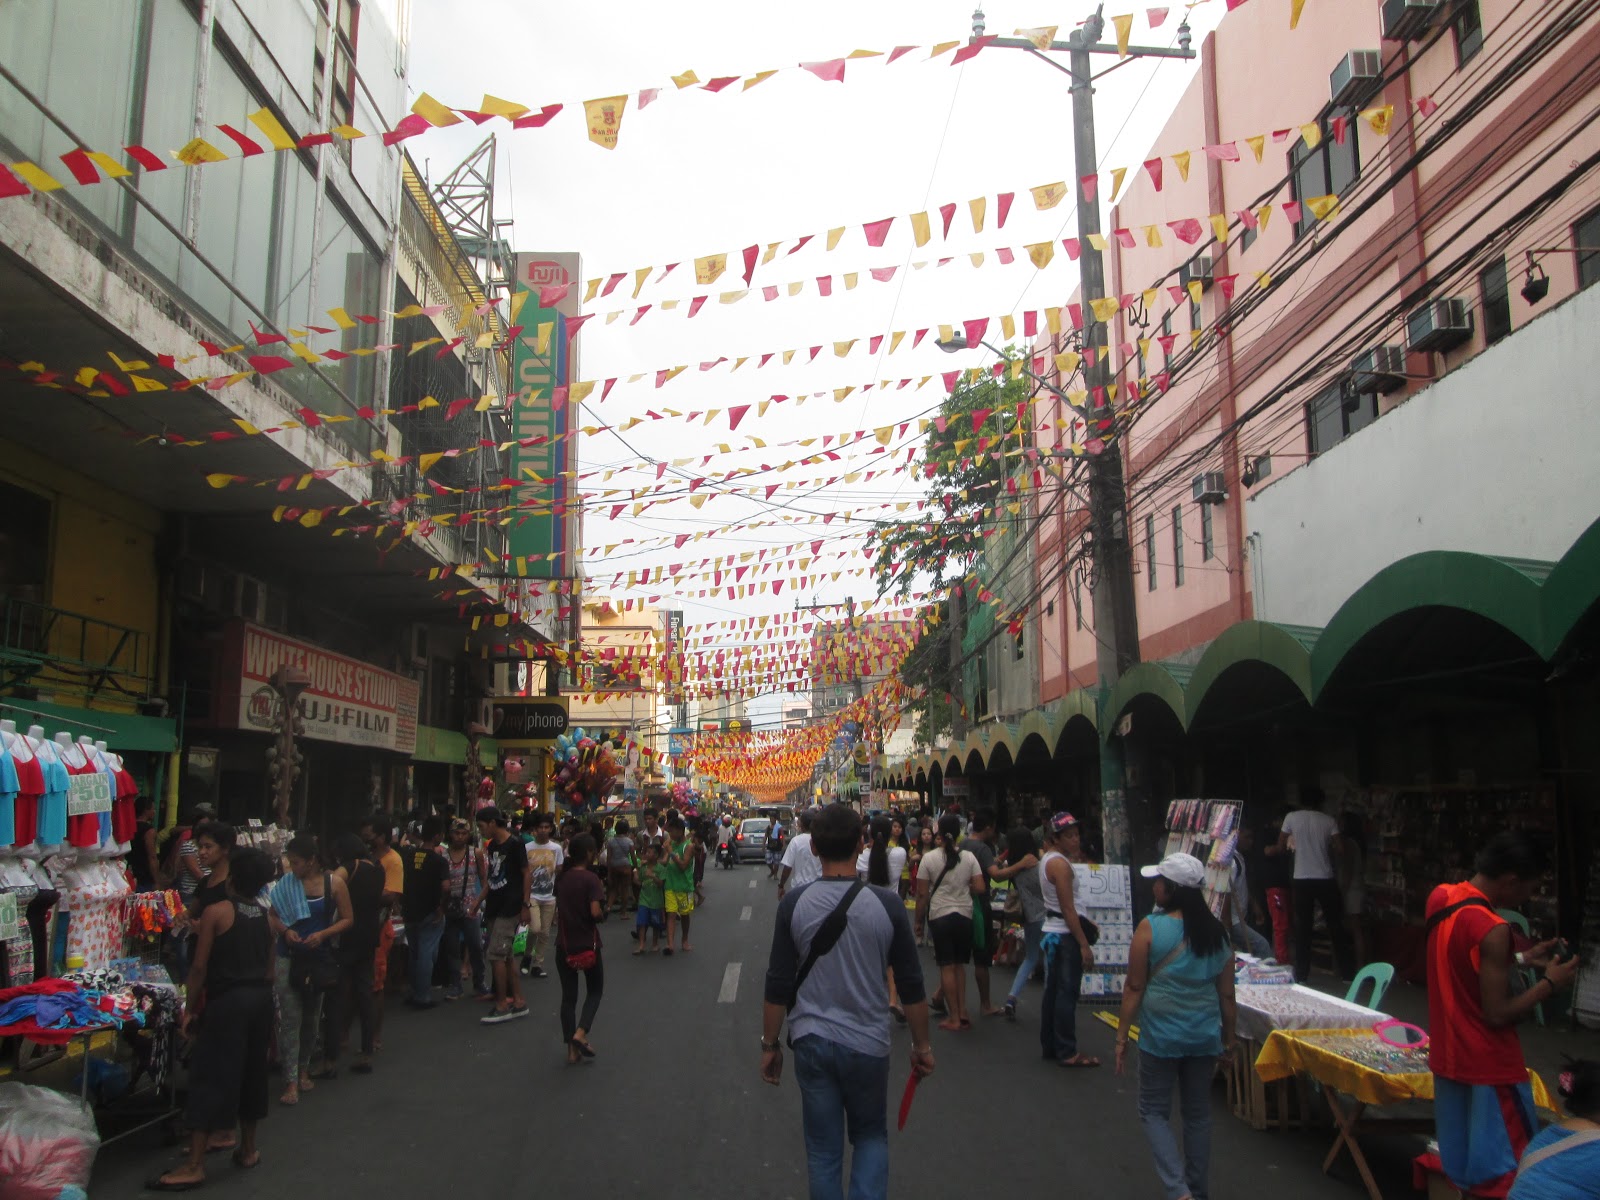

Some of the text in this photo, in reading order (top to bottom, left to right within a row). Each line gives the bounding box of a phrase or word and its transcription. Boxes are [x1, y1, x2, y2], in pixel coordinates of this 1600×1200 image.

[246, 632, 398, 709] WHITE HOUSE STUDIO
[300, 698, 389, 734] UJIFILM
